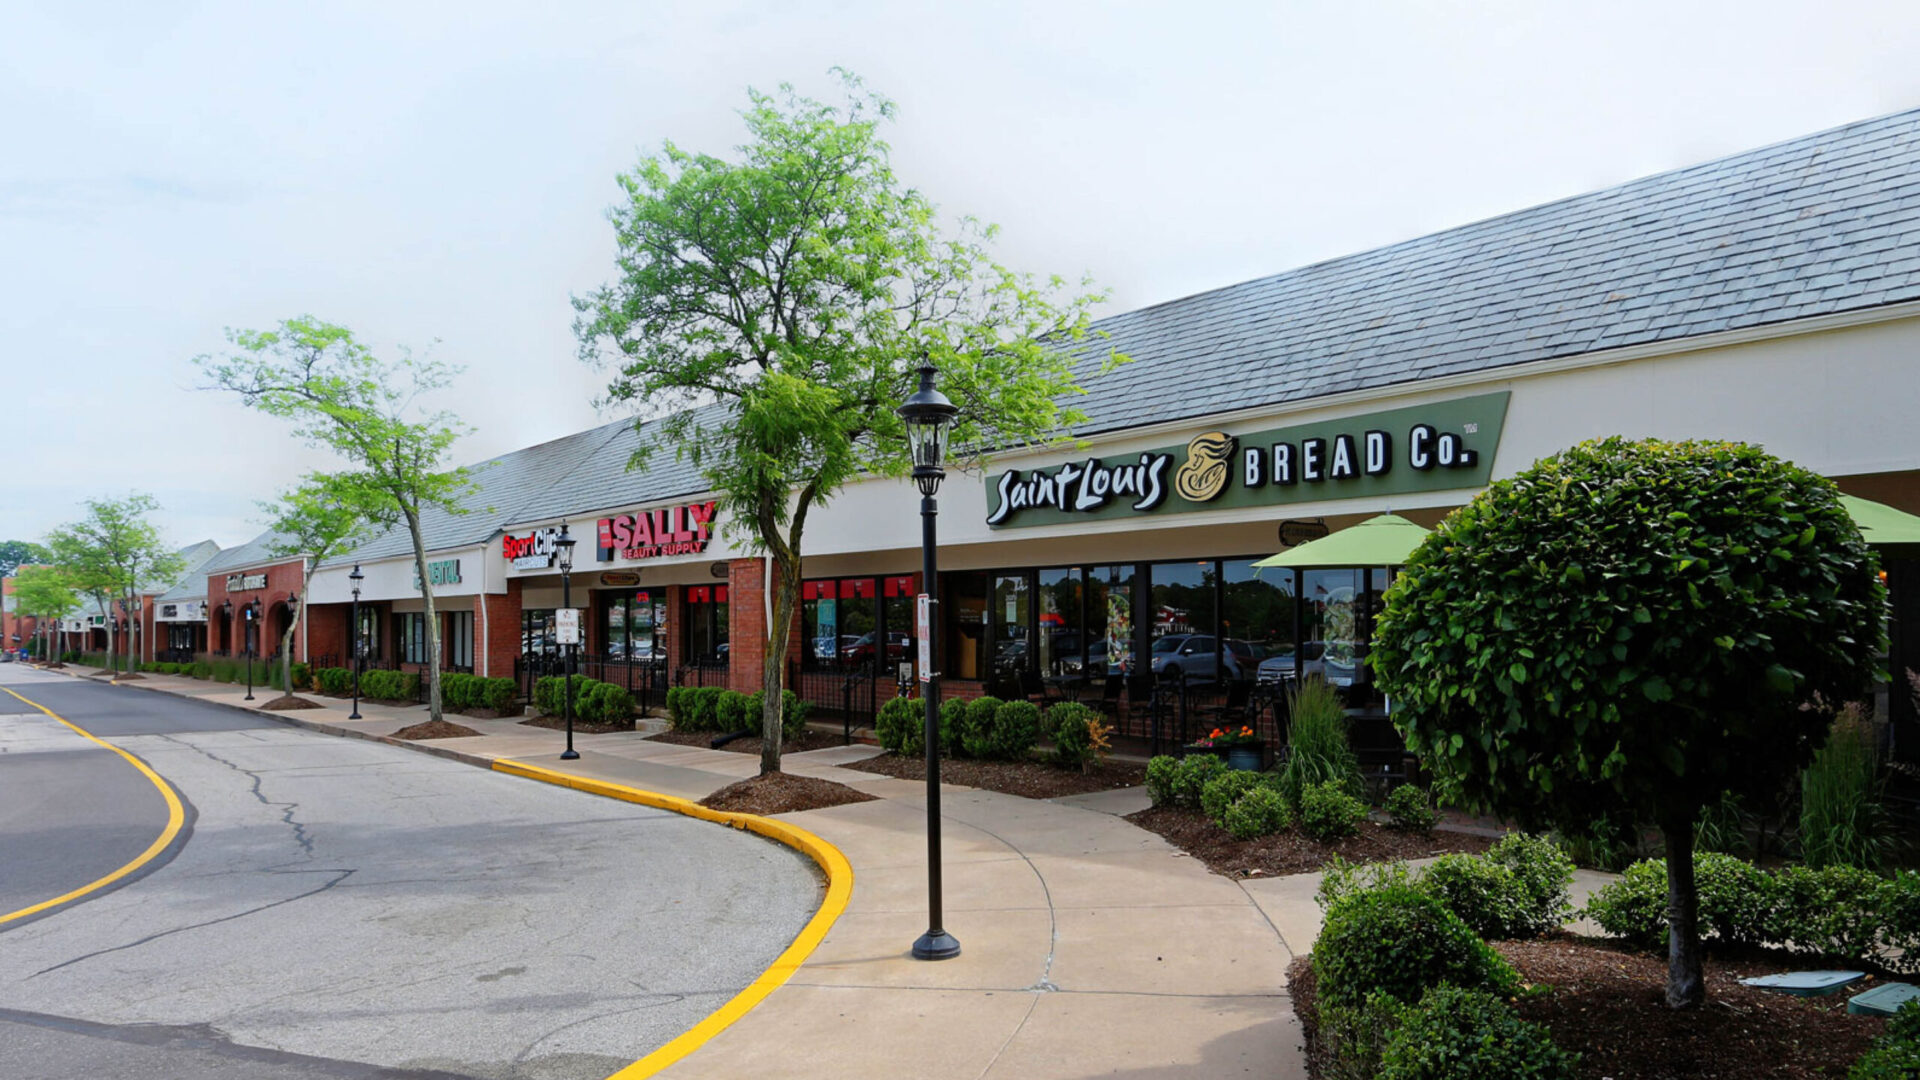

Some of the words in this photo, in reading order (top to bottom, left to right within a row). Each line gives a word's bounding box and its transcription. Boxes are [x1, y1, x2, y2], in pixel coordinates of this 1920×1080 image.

[987, 464, 1082, 524] Saint
[1075, 454, 1167, 510] Louis
[1244, 432, 1384, 486] BREAD
[1411, 426, 1469, 468] Co.
[612, 501, 717, 550] SALLY
[622, 546, 658, 560] BEAUTY
[661, 541, 702, 556] SUPPLY
